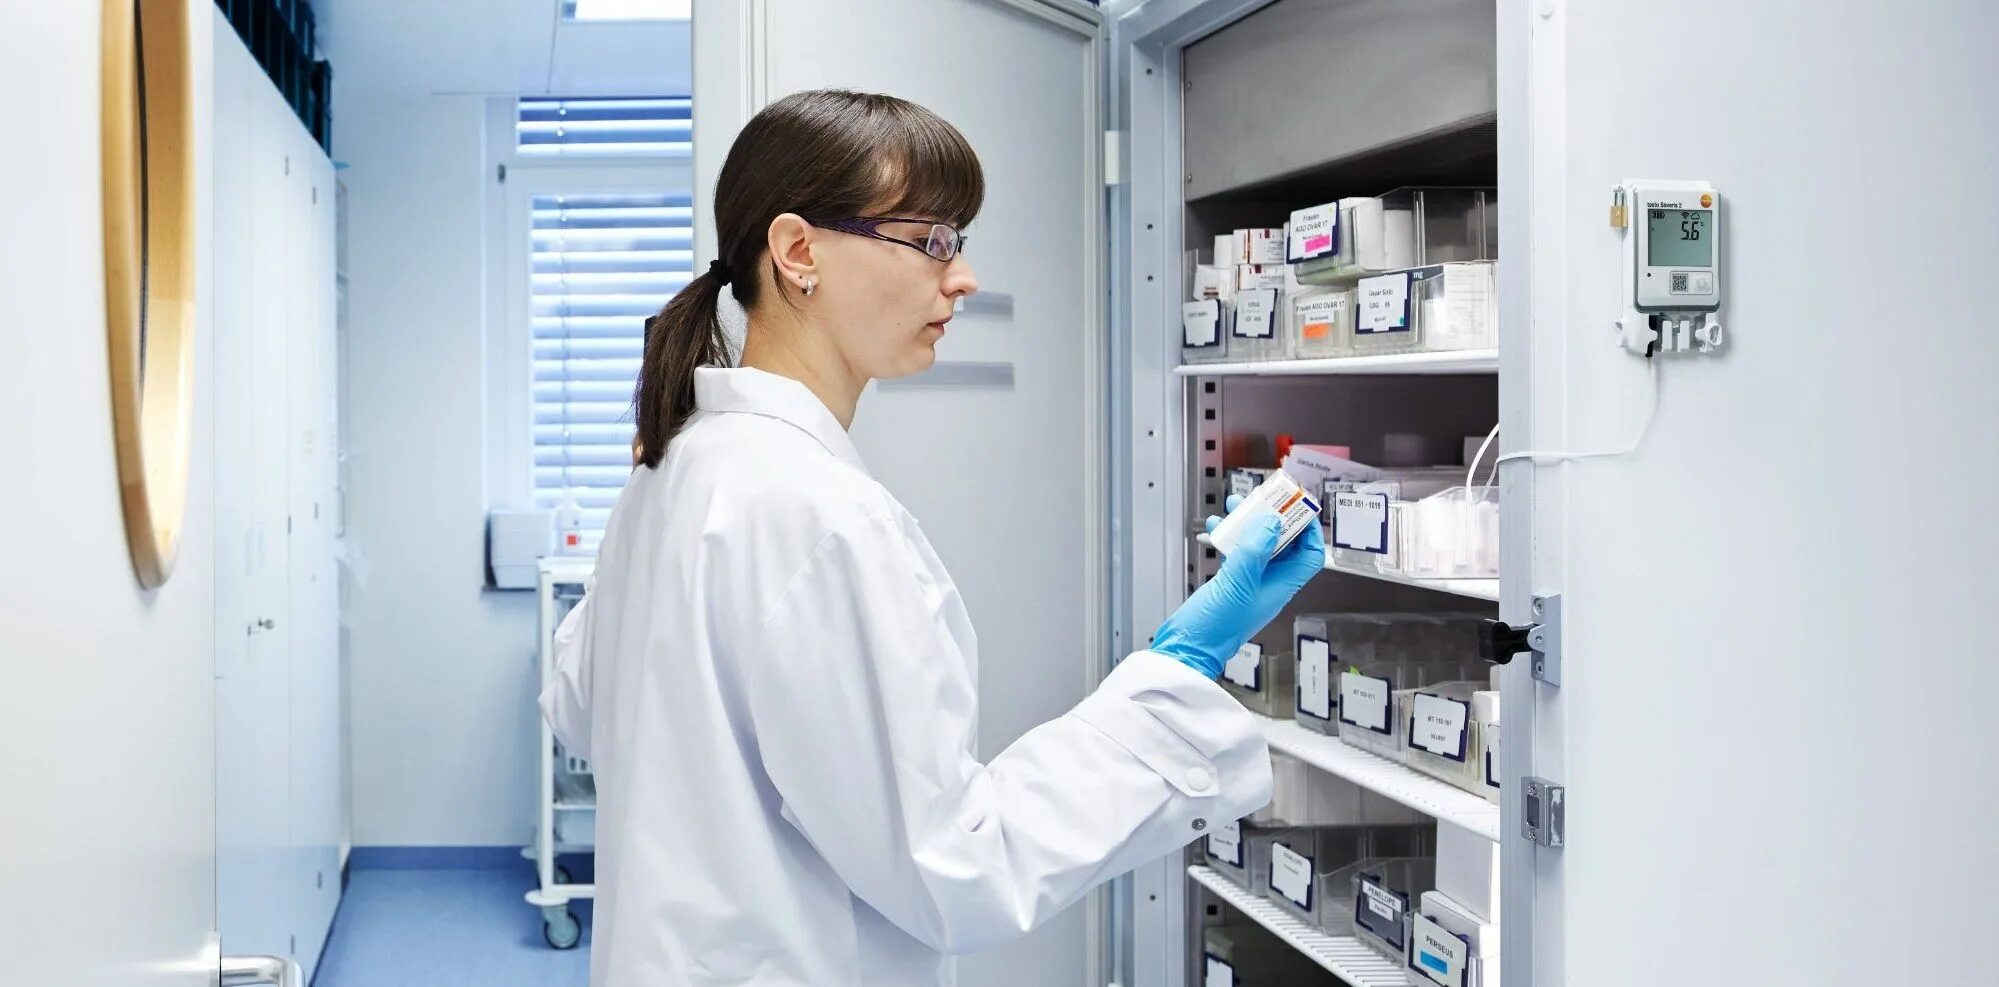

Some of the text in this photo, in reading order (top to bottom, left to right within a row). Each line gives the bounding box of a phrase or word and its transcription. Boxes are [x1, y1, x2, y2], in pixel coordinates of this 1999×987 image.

[1295, 224, 1307, 233] AGO
[1307, 221, 1322, 230] OVAR
[1681, 221, 1699, 240] 5.6
[1311, 302, 1323, 310] AGO
[1339, 499, 1353, 507] MEDI
[1368, 886, 1396, 906] PENELOPE
[1426, 935, 1454, 959] PERSEUS
